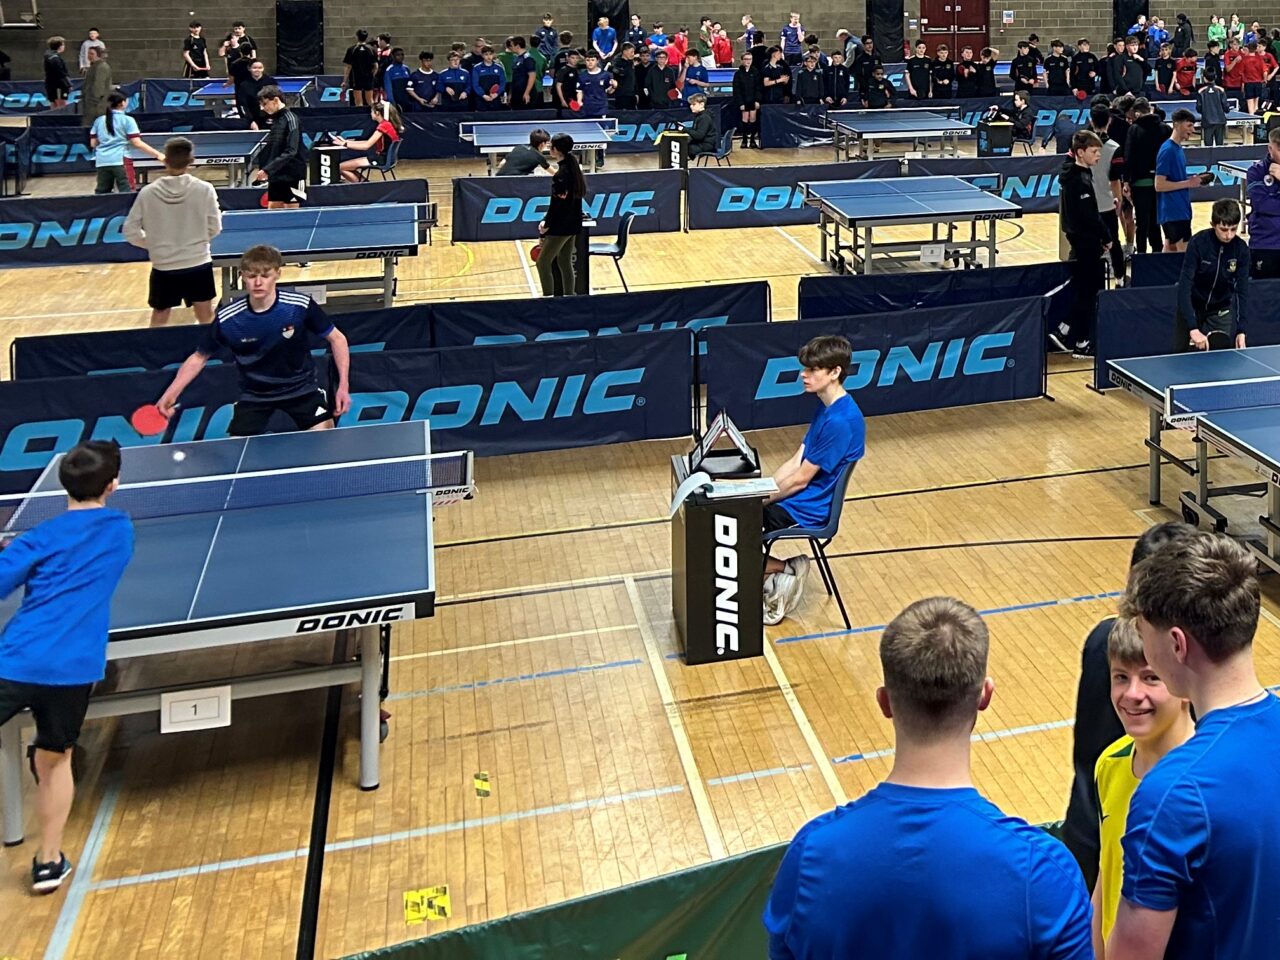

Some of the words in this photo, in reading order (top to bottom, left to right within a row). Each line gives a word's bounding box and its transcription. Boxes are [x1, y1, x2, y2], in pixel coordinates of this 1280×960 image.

[356, 250, 404, 259] DONIC
[1111, 372, 1133, 392] DONIC
[336, 367, 647, 431] DONIC
[1170, 416, 1196, 424] DONIC
[435, 487, 470, 496] DONIC
[714, 513, 739, 653] DONIC
[296, 606, 404, 633] DONIC
[191, 703, 197, 716] 1
